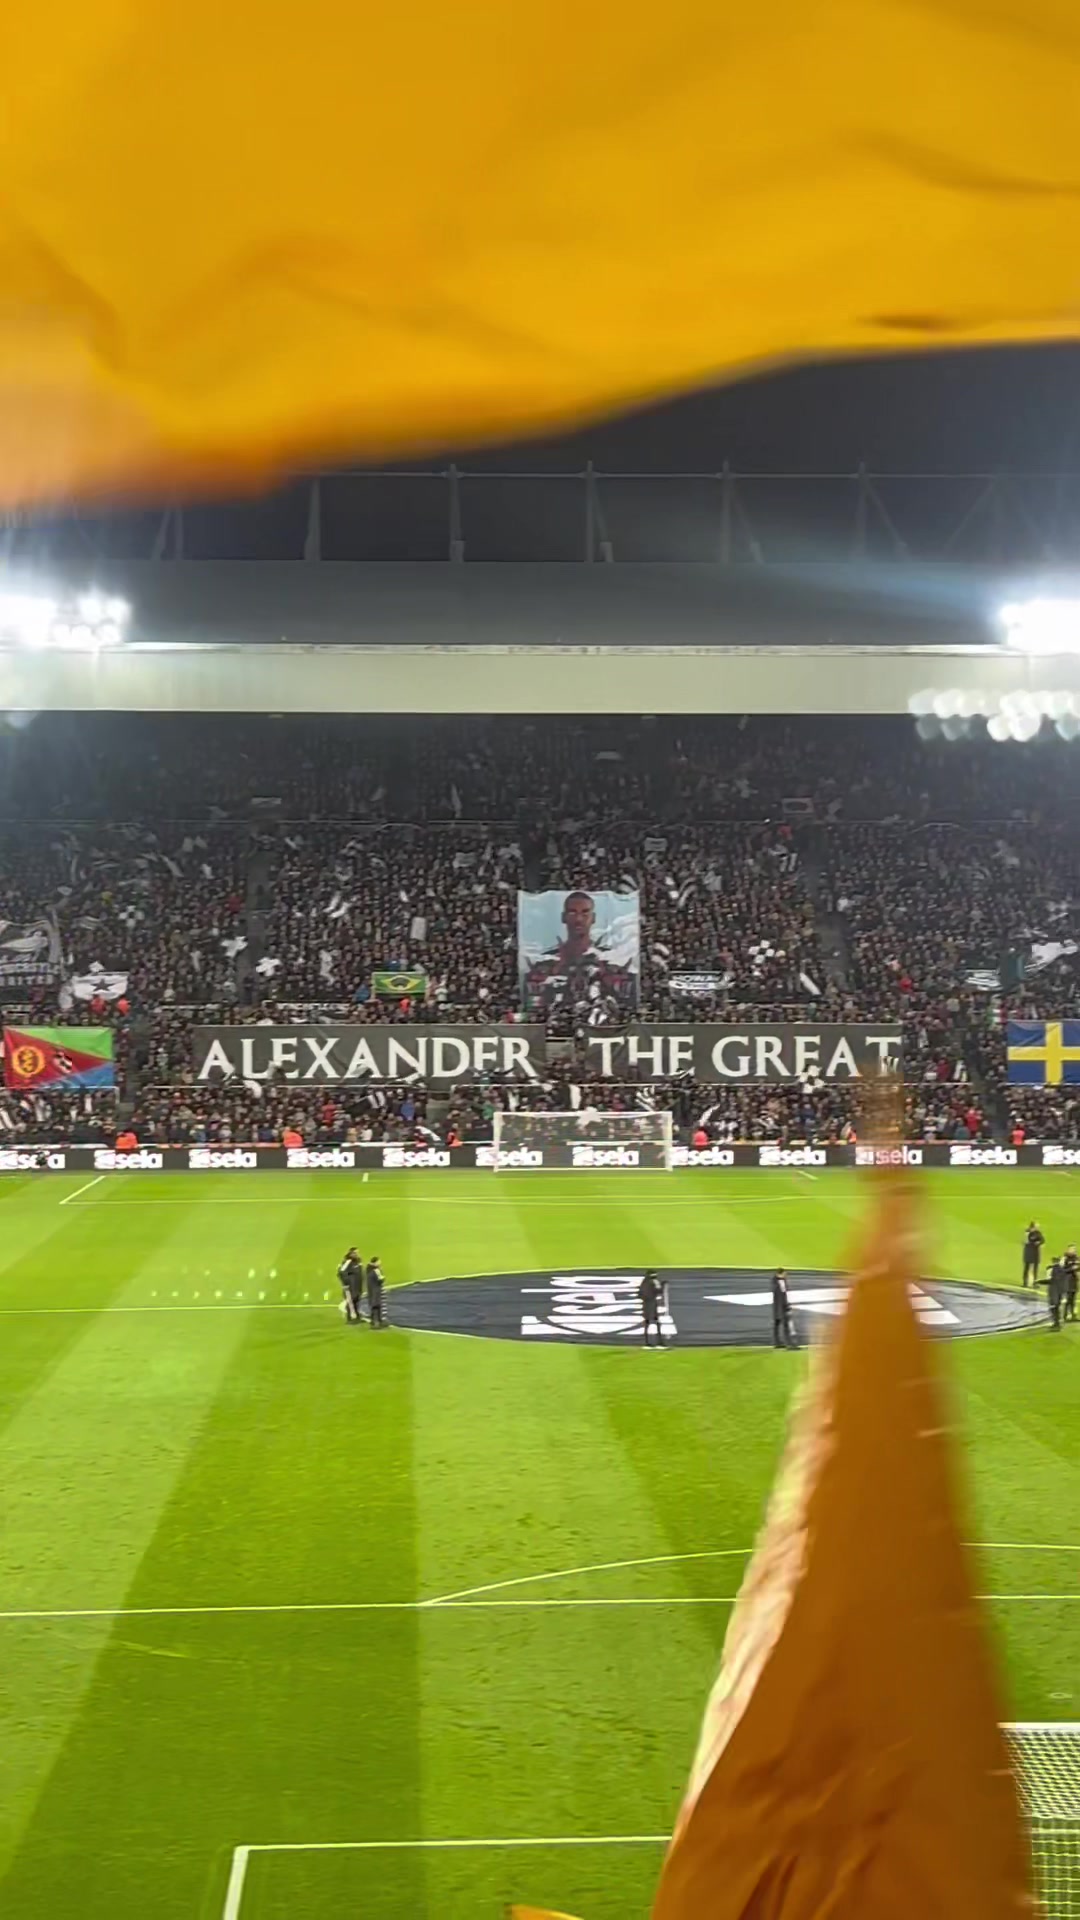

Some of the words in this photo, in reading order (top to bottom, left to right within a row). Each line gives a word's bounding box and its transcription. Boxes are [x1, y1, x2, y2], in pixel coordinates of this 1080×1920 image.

[198, 1037, 540, 1080] ALEXANDER
[588, 1036, 695, 1077] THE
[711, 1036, 902, 1077] GREAT
[115, 1150, 163, 1169] sela
[210, 1149, 257, 1168] sela
[308, 1148, 355, 1167] sela
[402, 1147, 450, 1167] sela
[593, 1146, 639, 1165] sela
[688, 1146, 734, 1165] sela
[780, 1146, 826, 1165] sela
[876, 1146, 922, 1164] sela
[970, 1146, 1017, 1165] sela
